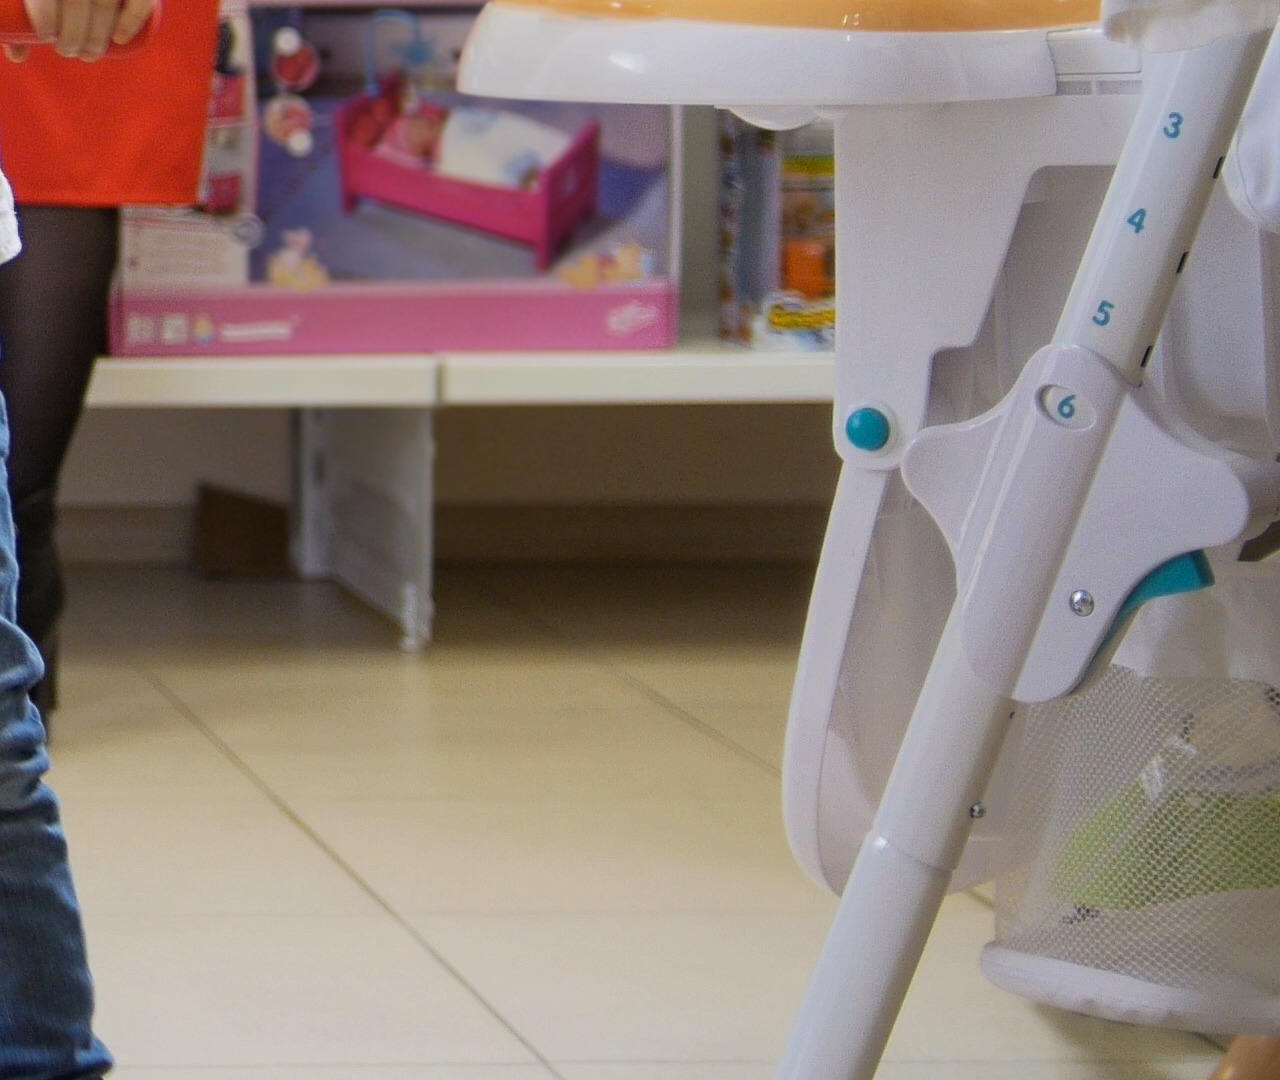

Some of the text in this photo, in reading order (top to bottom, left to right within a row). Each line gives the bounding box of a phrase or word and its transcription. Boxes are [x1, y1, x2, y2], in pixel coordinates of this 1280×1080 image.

[1164, 112, 1183, 139] 3
[1127, 208, 1147, 234] 4
[1092, 300, 1114, 326] 5
[1057, 395, 1076, 419] 6
